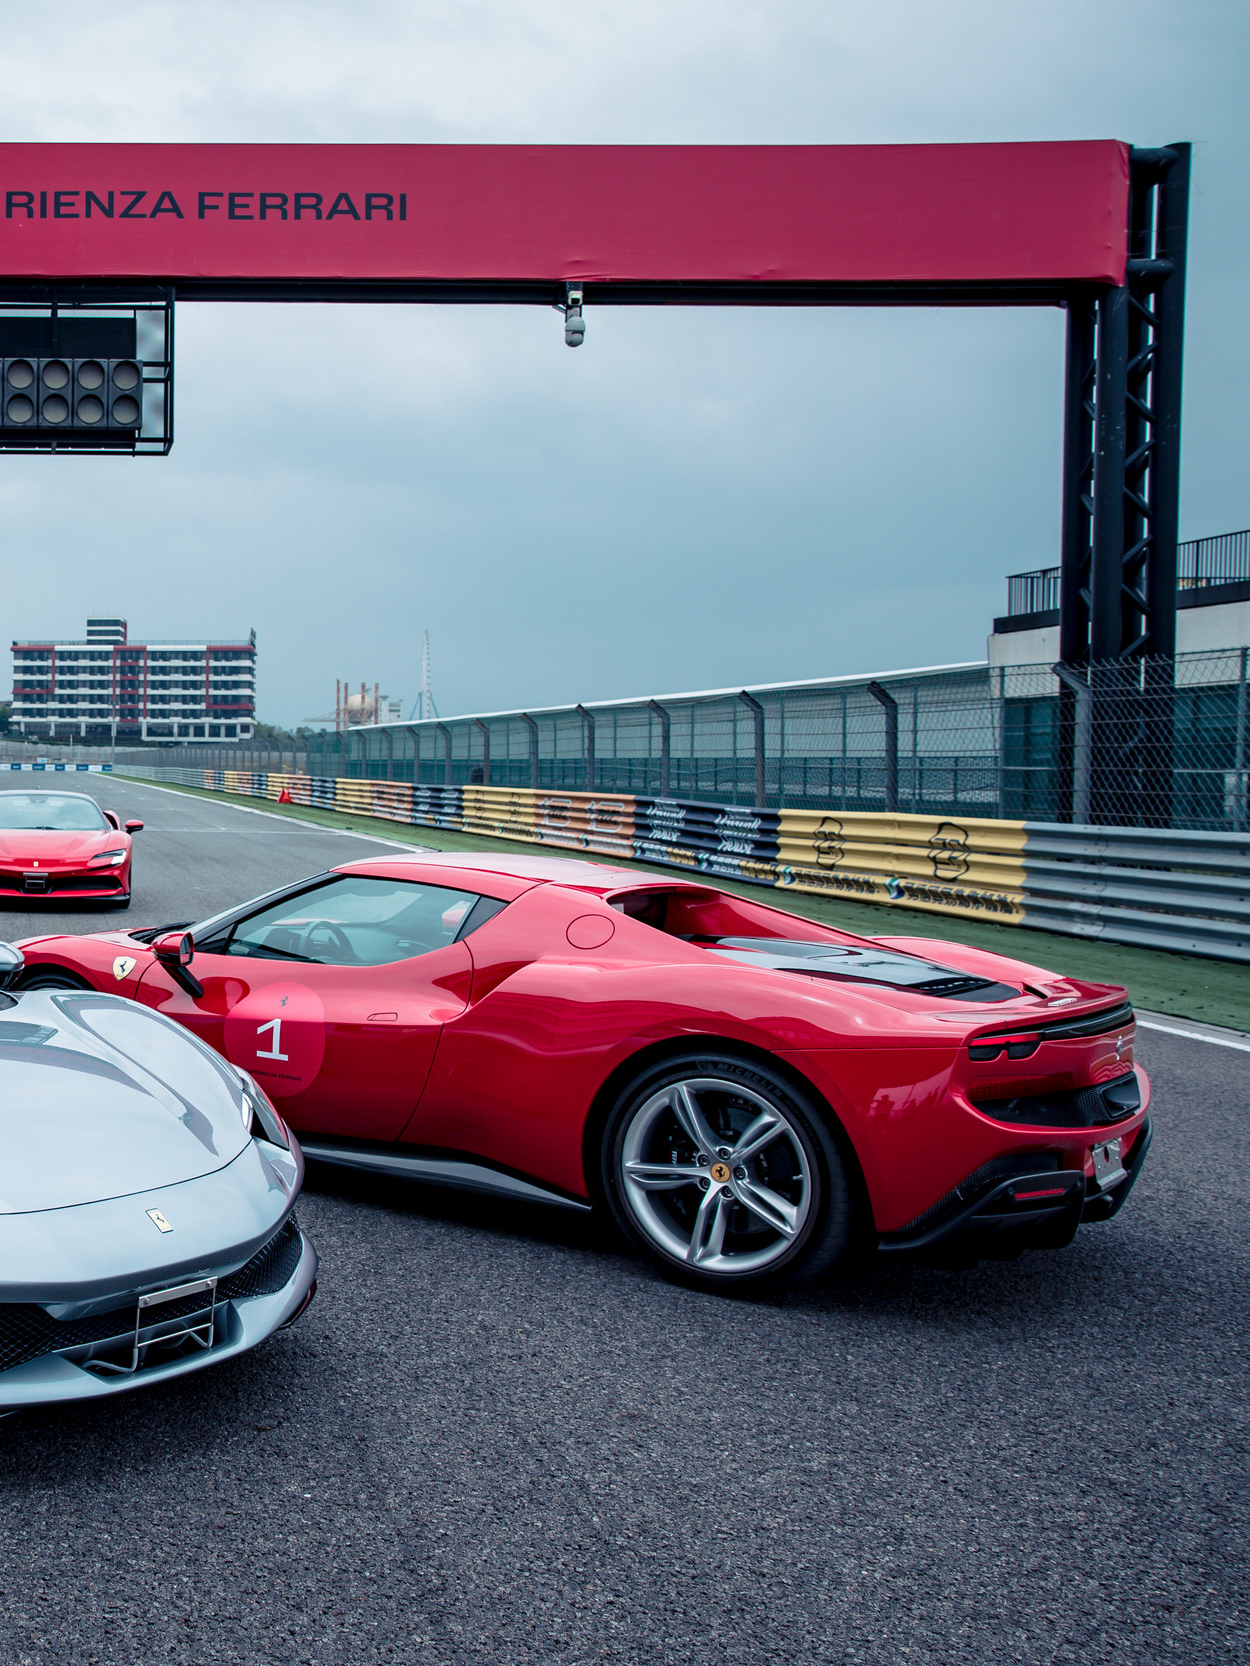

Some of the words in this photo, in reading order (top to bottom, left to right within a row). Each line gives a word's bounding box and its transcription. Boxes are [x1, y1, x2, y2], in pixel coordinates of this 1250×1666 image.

[198, 192, 408, 221] FERRARI
[256, 1018, 289, 1062] 1
[717, 1062, 783, 1097] MICHELIN
